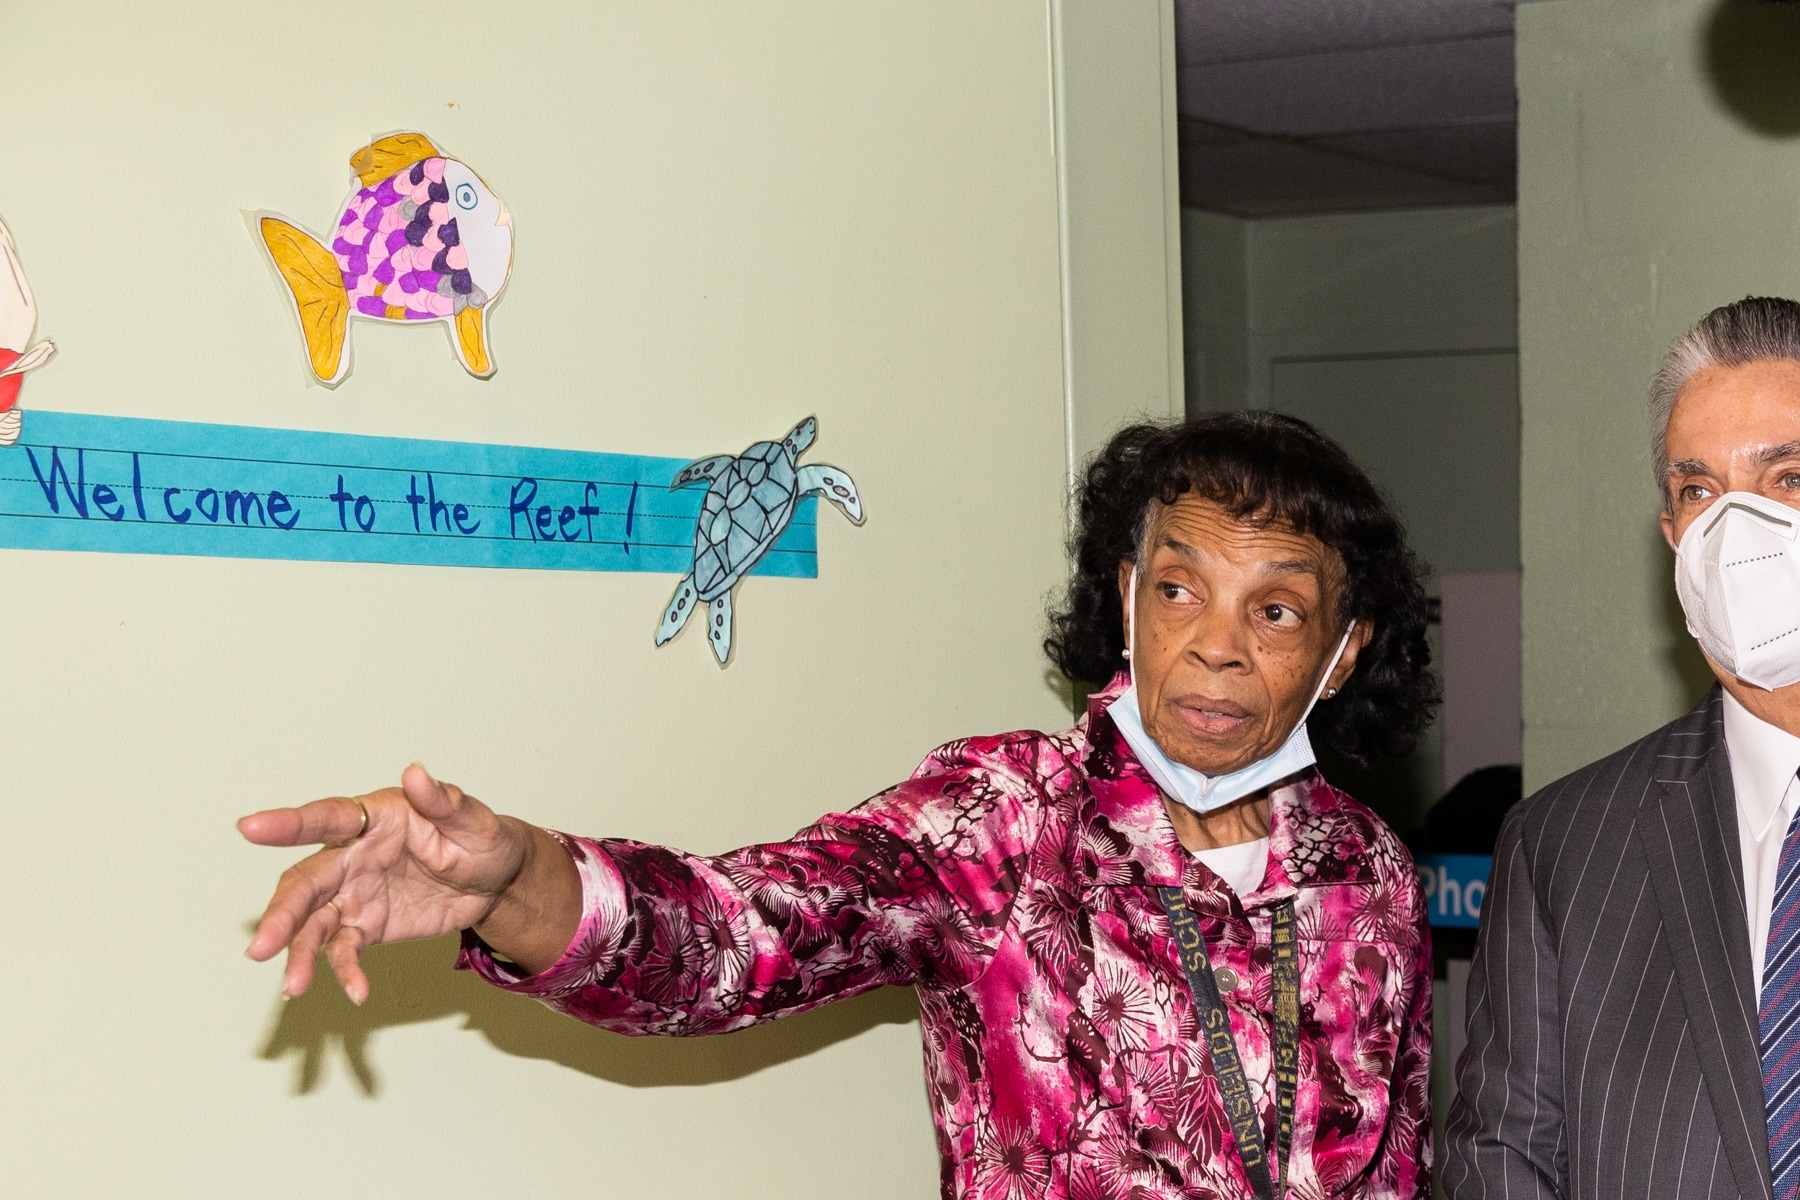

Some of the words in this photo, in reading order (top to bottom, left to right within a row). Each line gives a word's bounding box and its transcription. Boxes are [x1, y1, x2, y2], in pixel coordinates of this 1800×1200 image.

[25, 444, 301, 530] Welcome
[330, 474, 376, 532] to
[405, 471, 482, 535] the
